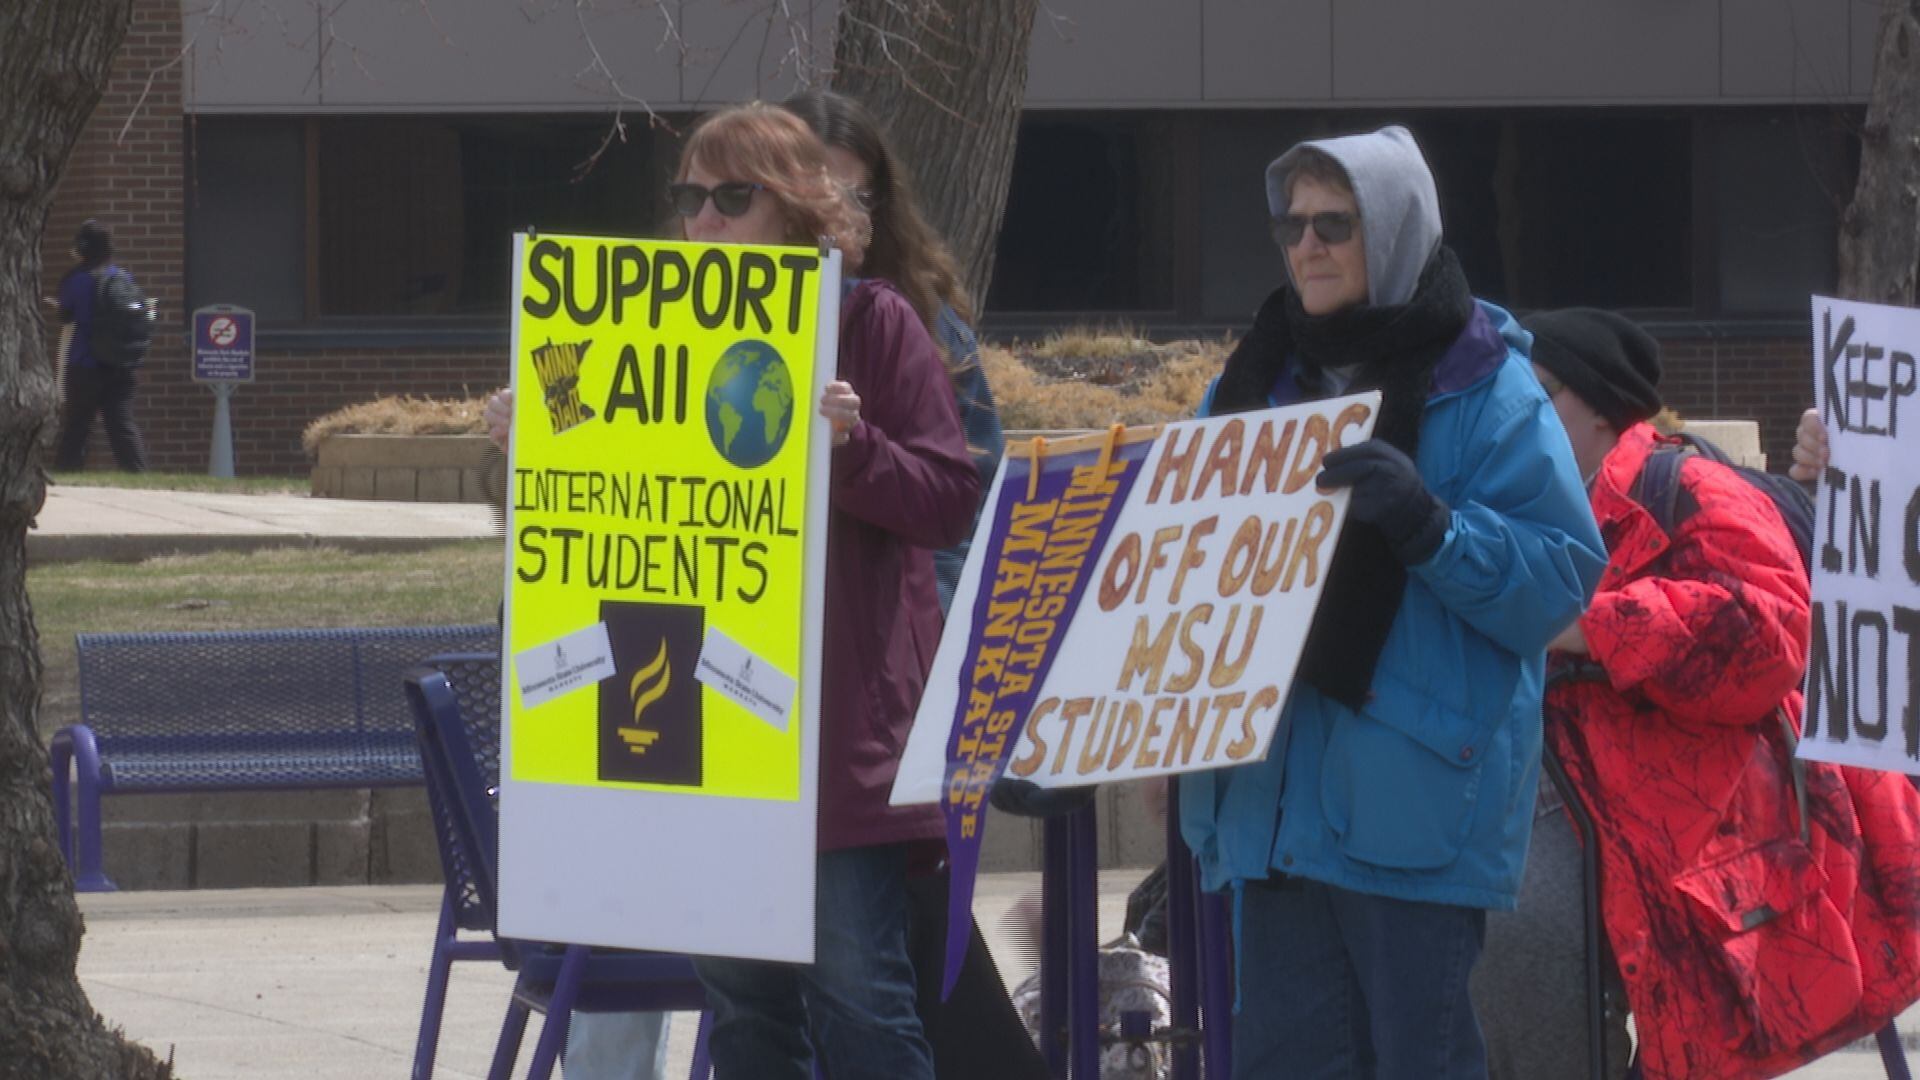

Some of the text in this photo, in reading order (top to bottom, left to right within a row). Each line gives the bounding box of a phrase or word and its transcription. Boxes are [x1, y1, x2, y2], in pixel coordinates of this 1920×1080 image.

[522, 239, 819, 335] SUPPORT
[1823, 306, 1918, 439] KEEP
[514, 468, 799, 537] INTERNATIONAL
[1146, 402, 1371, 505] HANDS
[517, 526, 769, 604] STUDENTS
[1097, 500, 1334, 612] OFF OUR
[1821, 465, 1882, 579] IN
[949, 498, 1060, 806] MANKATO
[960, 459, 1130, 839] MINNESOTA STATE
[1116, 603, 1265, 696] MSU
[1010, 685, 1280, 777] STUDENTS
